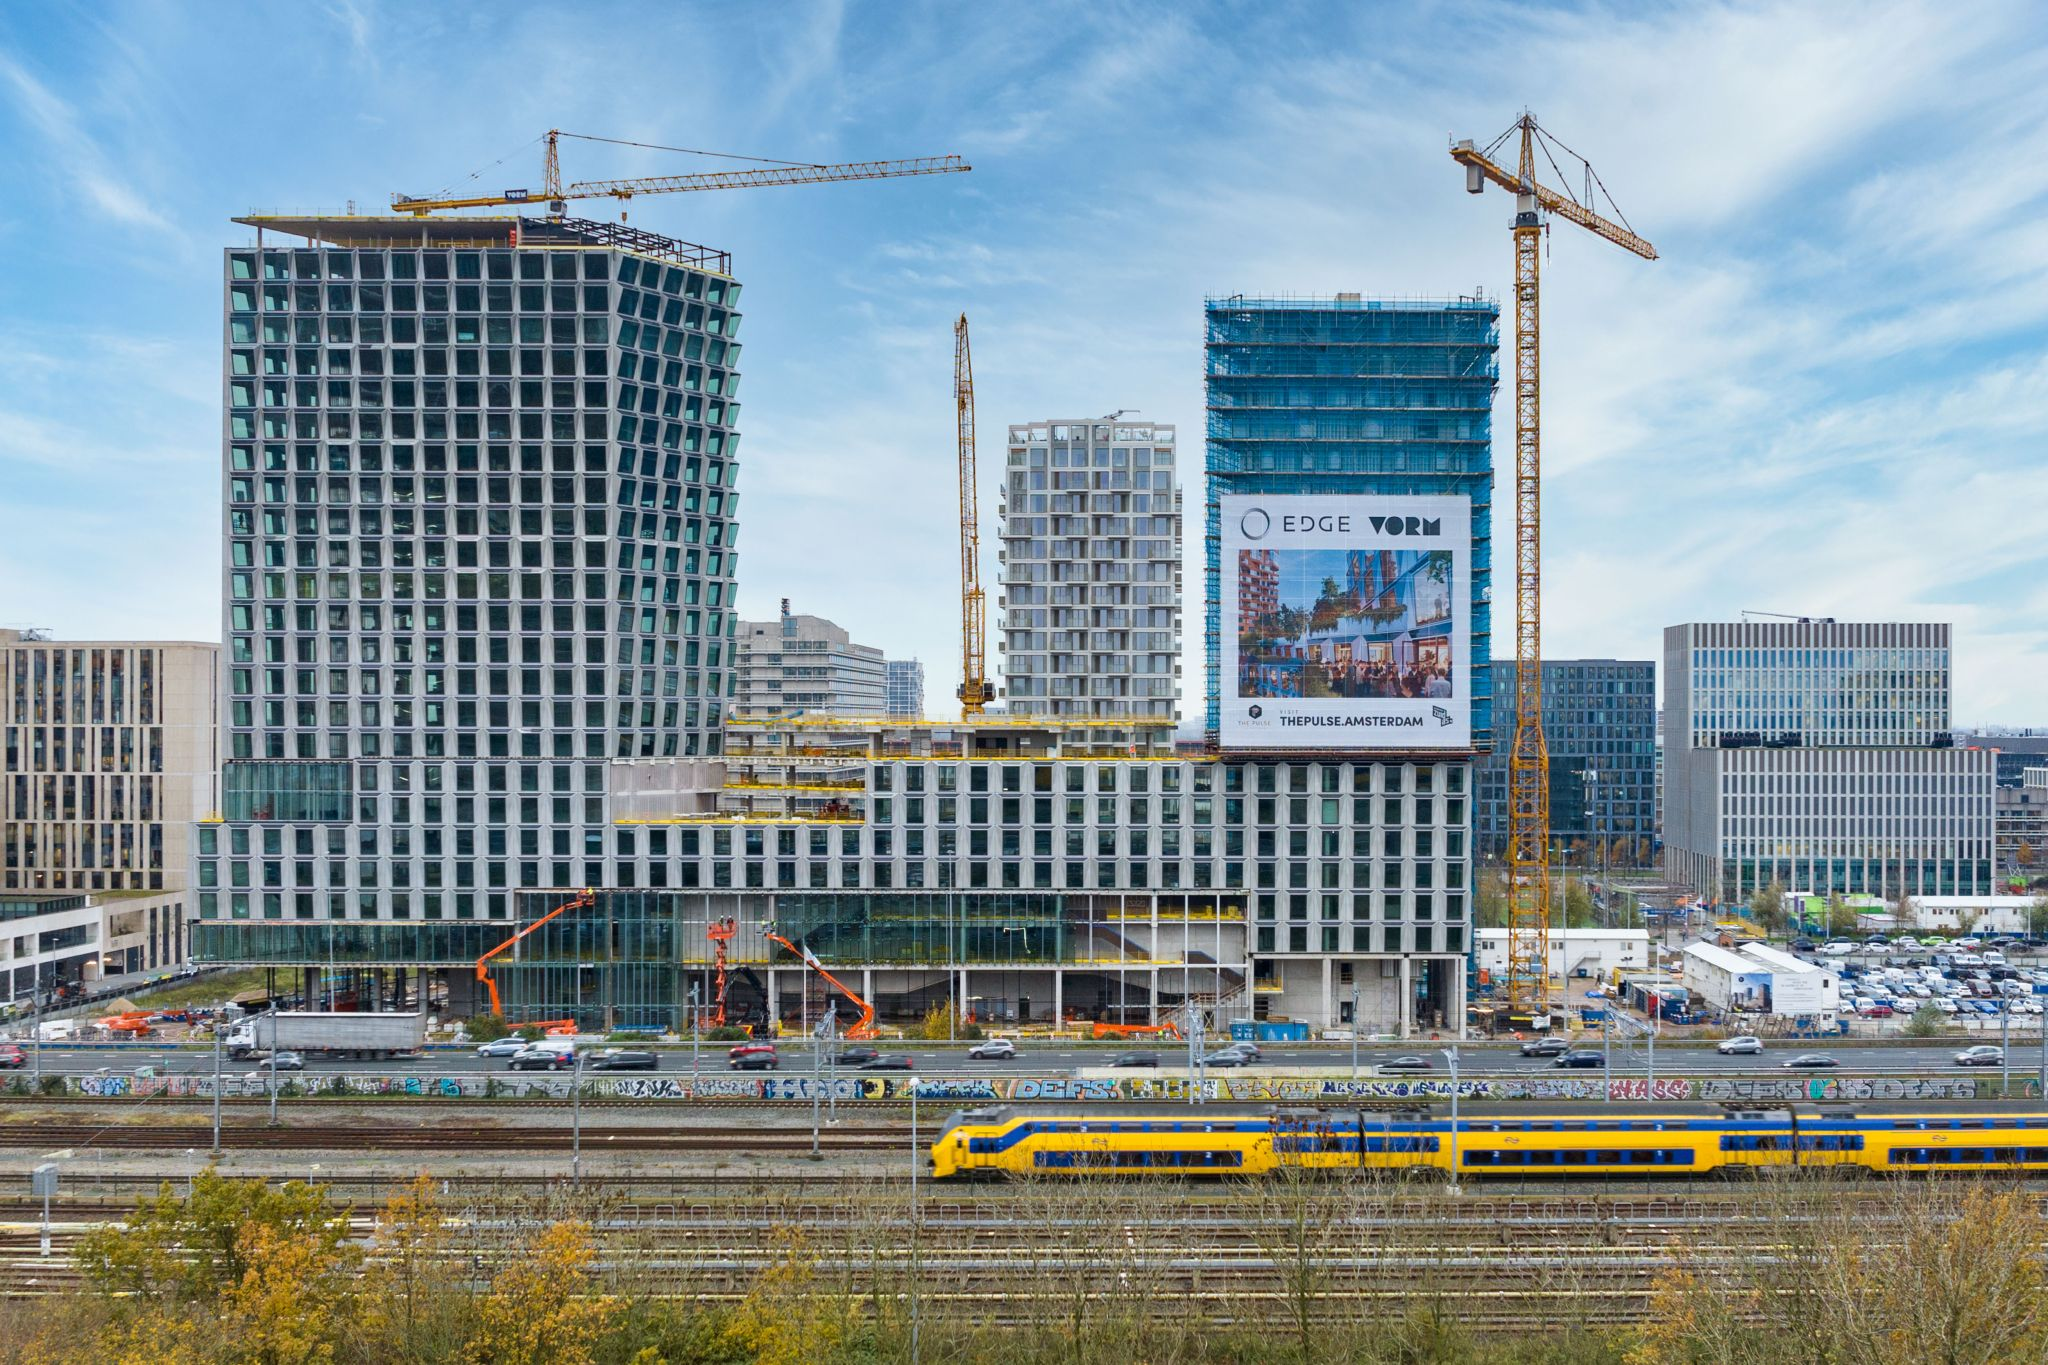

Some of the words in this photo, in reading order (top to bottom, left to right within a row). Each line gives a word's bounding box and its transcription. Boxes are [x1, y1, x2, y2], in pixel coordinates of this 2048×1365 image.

[1283, 515, 1350, 532] EDGE
[1368, 515, 1441, 536] VORM
[1280, 716, 1423, 727] THEPULSE.AMSTERDAM
